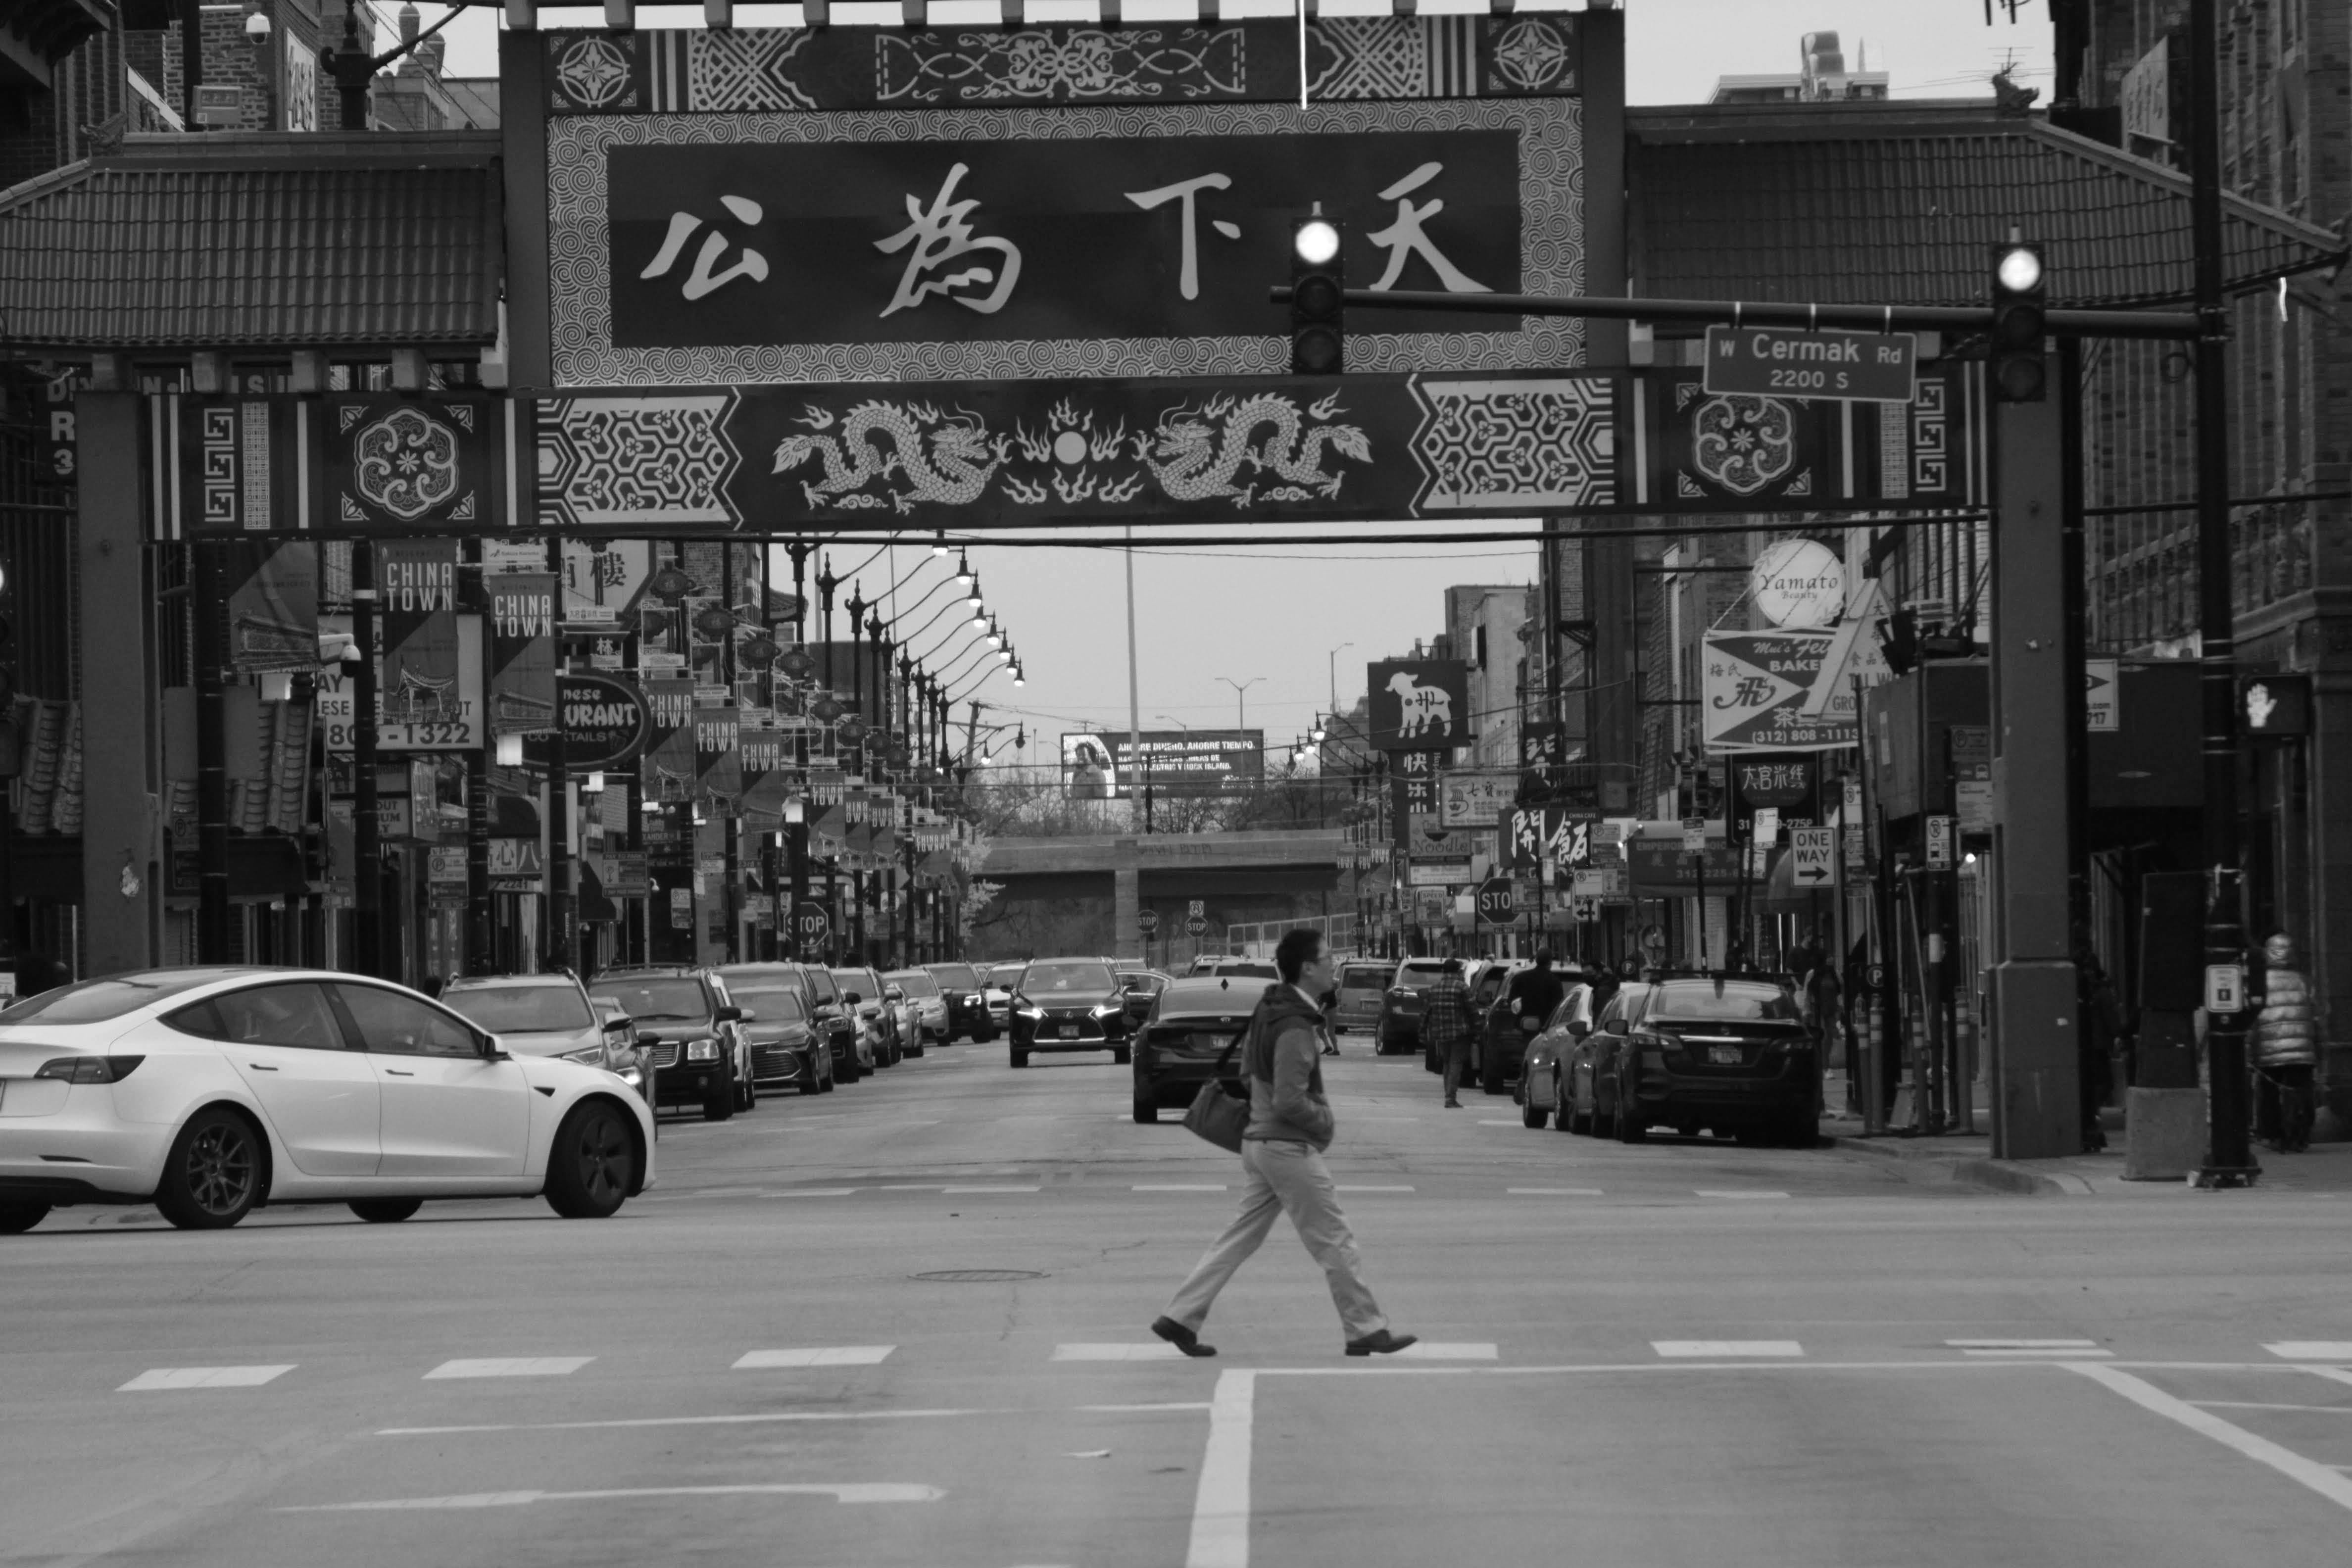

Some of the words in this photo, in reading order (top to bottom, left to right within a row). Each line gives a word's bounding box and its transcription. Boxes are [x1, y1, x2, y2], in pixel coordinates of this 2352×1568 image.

[1719, 340, 1735, 357] W
[1752, 334, 1860, 362] Cermak
[1877, 346, 1902, 364] Rd
[1770, 369, 1825, 388] 2200
[1836, 372, 1849, 389] S
[387, 562, 452, 587] CHINA
[1760, 574, 1838, 590] Yamato
[387, 587, 453, 612] TOWN
[495, 595, 551, 616] CHINA
[494, 616, 551, 637] TOWN
[1792, 638, 1830, 658] Fei
[1769, 660, 1821, 672] BAKE
[563, 688, 602, 701] nese
[652, 712, 691, 728] OWN
[329, 723, 470, 745] 80-1322
[528, 732, 607, 742] COTAILS
[697, 722, 737, 737] CHINA
[1752, 730, 1787, 745] (312)
[1791, 729, 1816, 741] 808
[697, 737, 738, 752] TOWN
[742, 744, 779, 757] CHINA
[1187, 741, 1220, 750] AHORRE
[742, 757, 779, 772] TOWN
[845, 801, 868, 813] HINA
[845, 813, 868, 823] OWN
[1636, 842, 1684, 851] EMPEROR
[1797, 833, 1829, 846] ONE
[1797, 849, 1829, 863] WAY
[1481, 892, 1511, 910] STO
[787, 916, 825, 933] TOP
[1138, 916, 1157, 925] STOP
[1187, 922, 1206, 931] STOP
